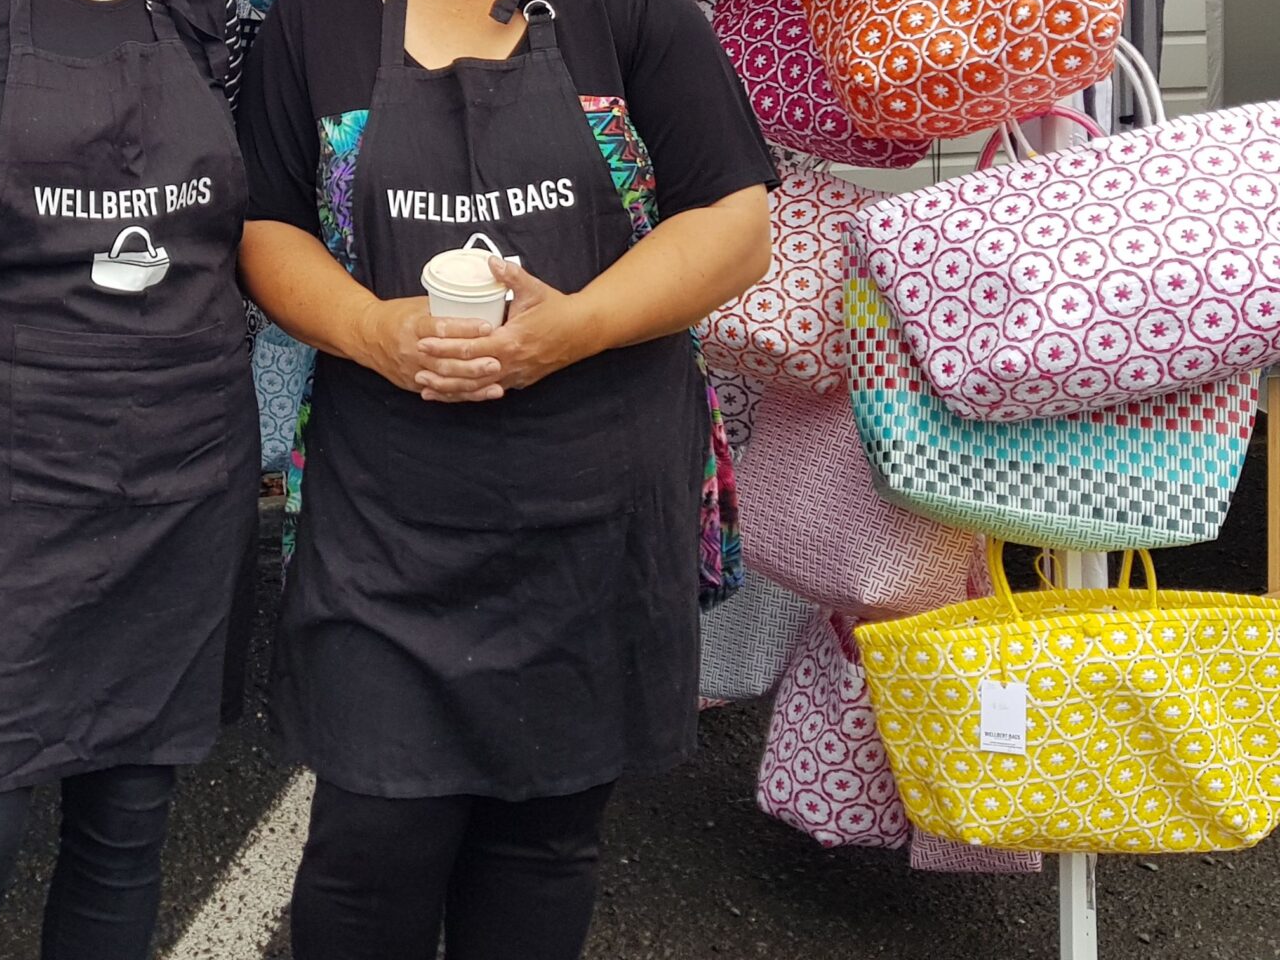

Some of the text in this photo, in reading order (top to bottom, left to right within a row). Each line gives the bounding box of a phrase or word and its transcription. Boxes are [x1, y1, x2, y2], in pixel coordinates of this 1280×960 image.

[34, 177, 212, 219] WELLBERT BAGS
[506, 177, 575, 217] BAGS
